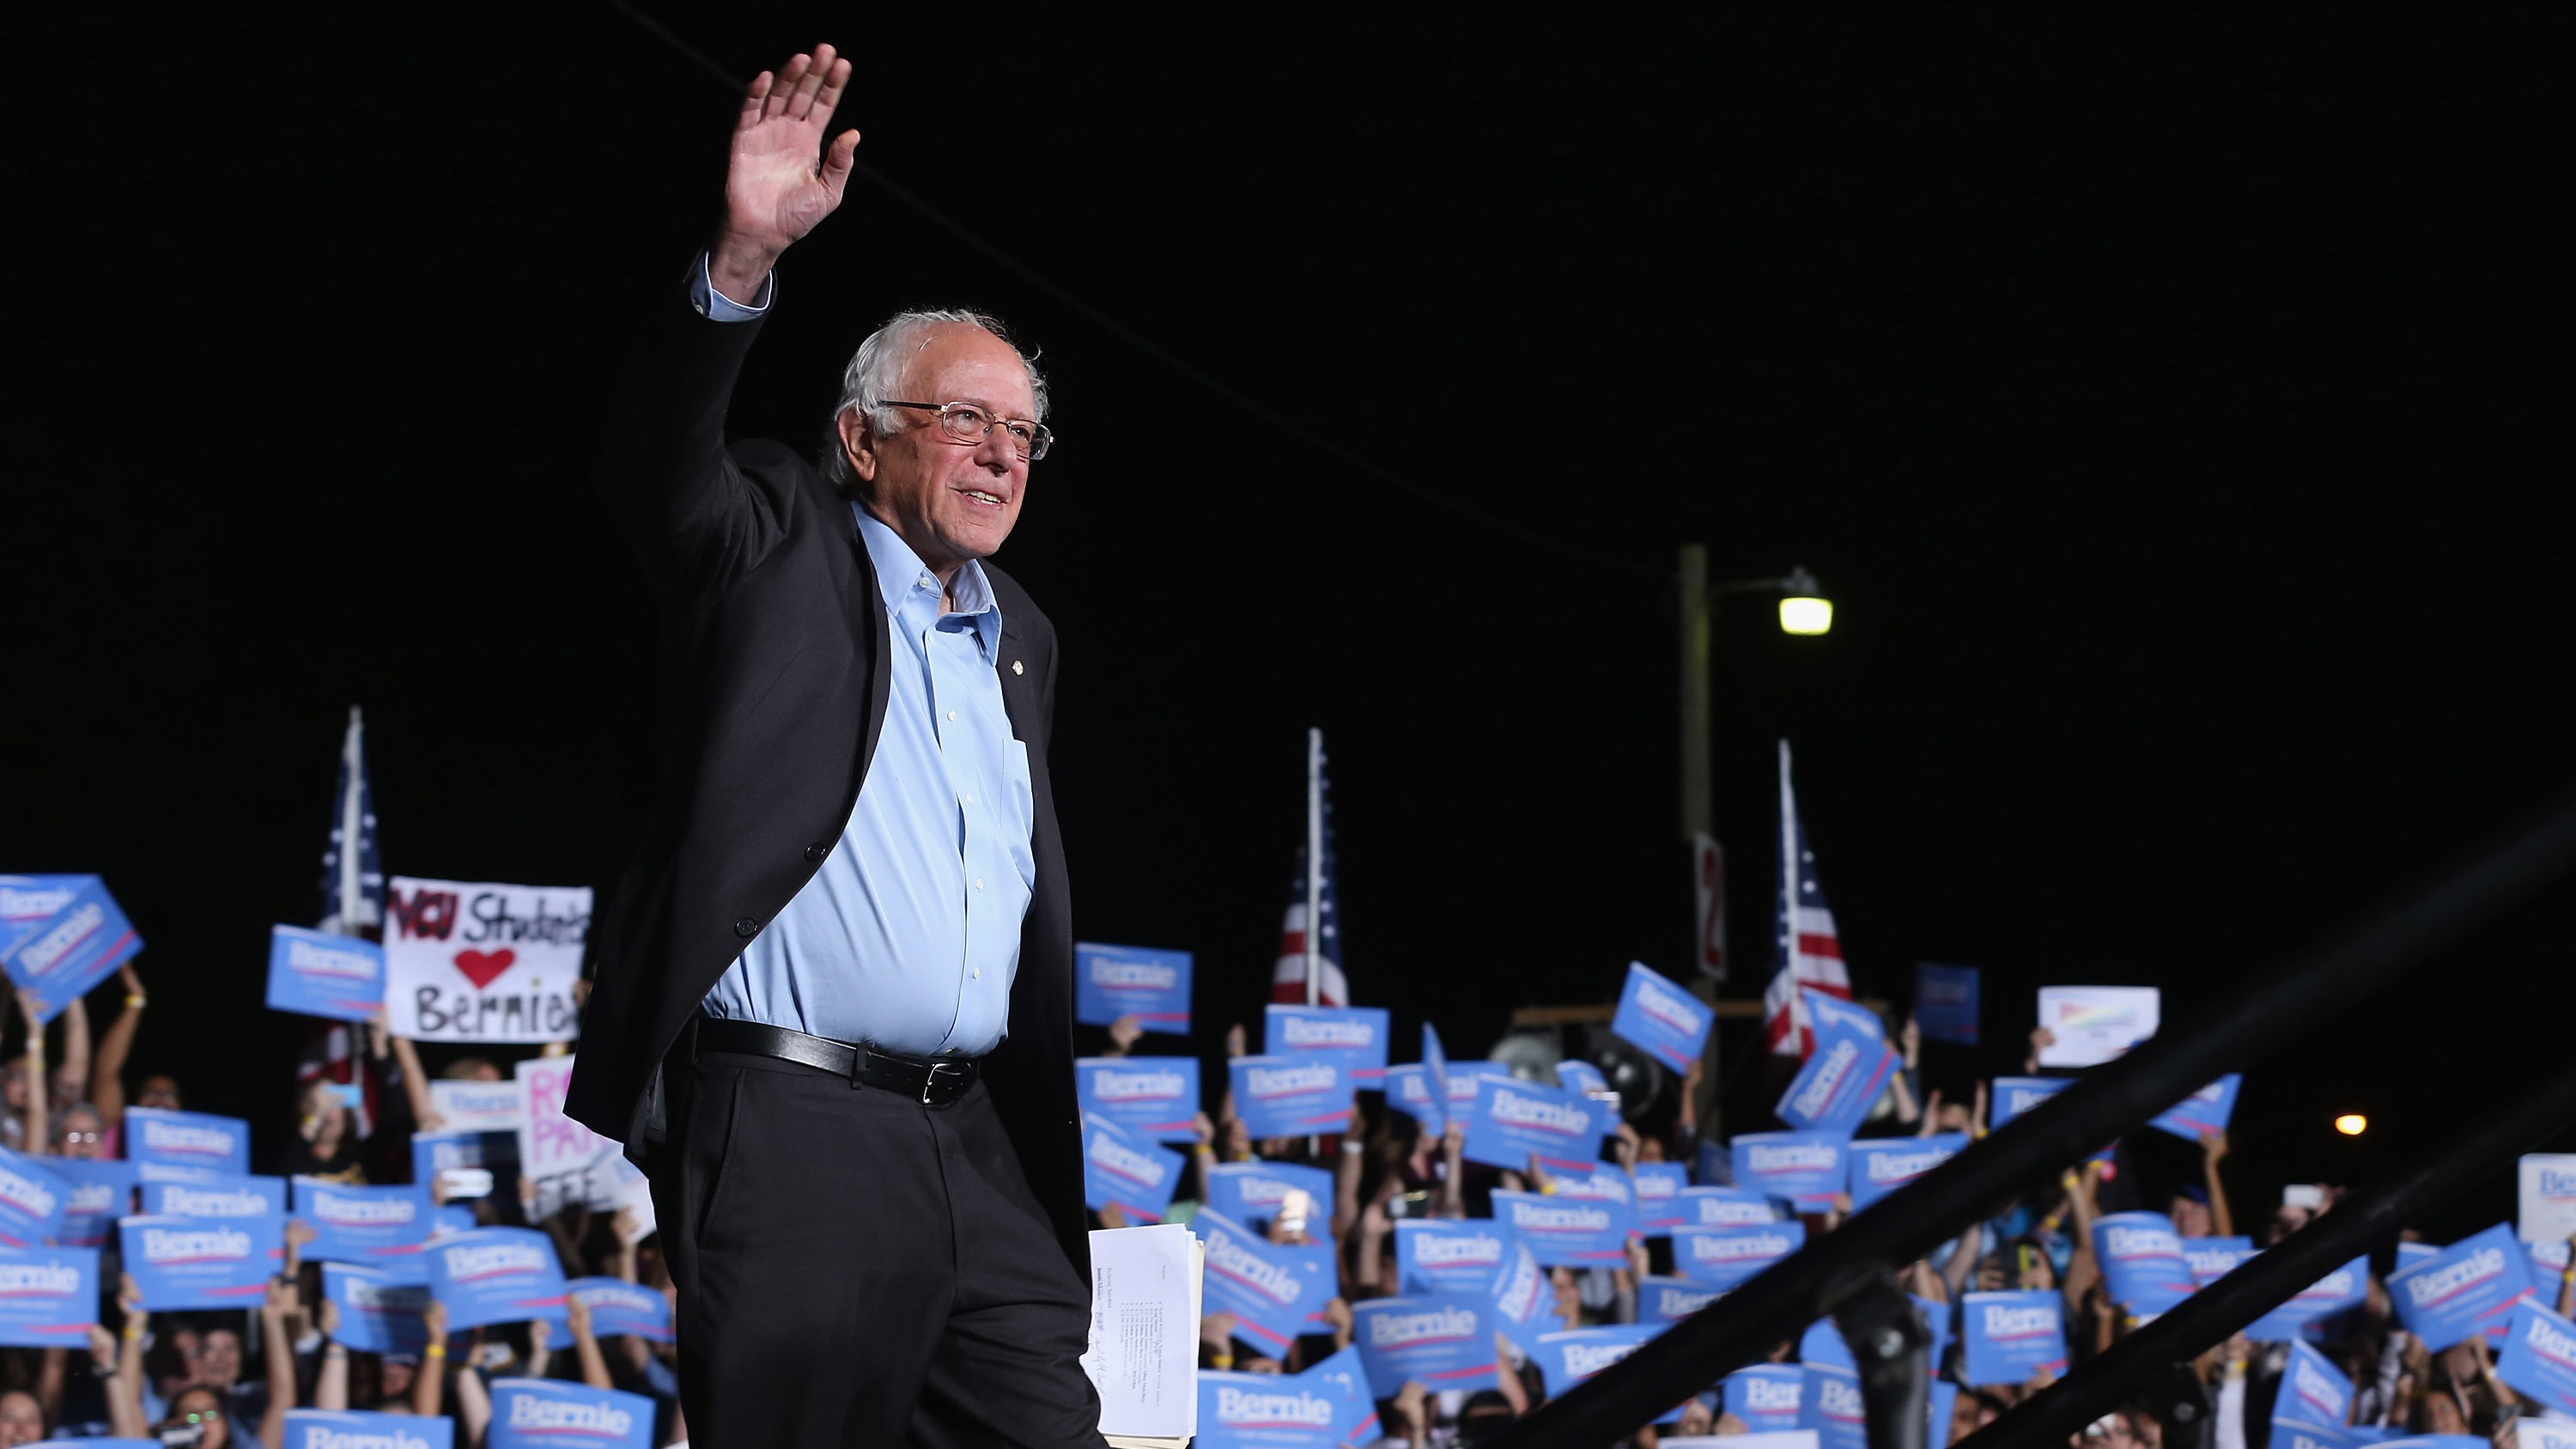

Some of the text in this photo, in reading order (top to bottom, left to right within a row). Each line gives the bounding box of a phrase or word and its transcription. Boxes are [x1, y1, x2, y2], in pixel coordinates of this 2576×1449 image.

[1091, 956, 1177, 989] Bernie
[416, 978, 580, 1033] Bernie
[1283, 1015, 1374, 1046] Bernie
[1092, 1068, 1185, 1099] Bernie
[1248, 1062, 1337, 1097] Bernie
[1492, 1088, 1590, 1135] Bernie
[143, 1119, 234, 1155] Bernie
[1748, 1142, 1838, 1171] Bernie
[162, 1185, 269, 1217] Bernie
[313, 1191, 416, 1222] Bernie
[1512, 1202, 1610, 1230] Bernie
[143, 1226, 252, 1259] Bernie
[1413, 1232, 1503, 1263] Bernie
[1693, 1232, 1789, 1260] Bernie
[0, 1260, 81, 1294] ernie
[443, 1242, 547, 1280] Bernie
[1205, 1228, 1302, 1305] Bernie
[2407, 1245, 2506, 1307] Bernie
[1370, 1306, 1477, 1349] Bernie
[510, 1392, 632, 1436] Bernie
[1217, 1386, 1334, 1426] Bernie
